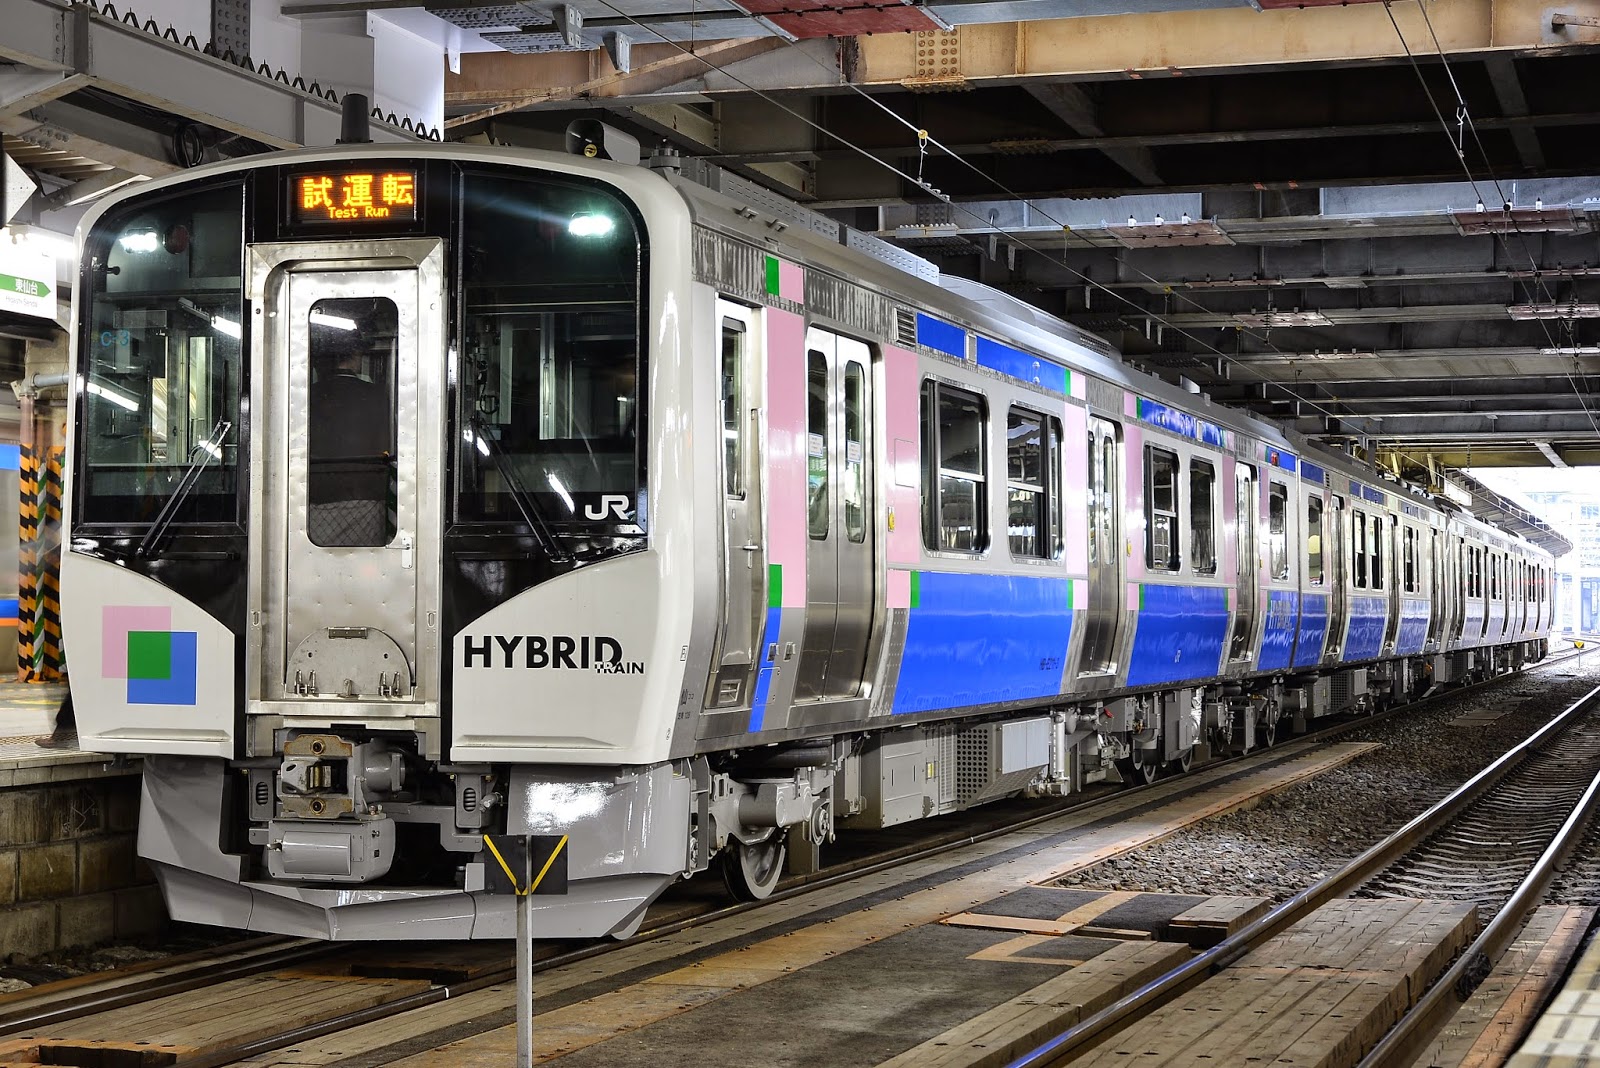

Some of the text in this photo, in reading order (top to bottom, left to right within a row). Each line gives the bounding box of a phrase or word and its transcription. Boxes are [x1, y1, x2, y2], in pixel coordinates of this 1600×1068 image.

[303, 174, 413, 208] 試運転
[328, 205, 389, 219] Test Run
[15, 278, 38, 296] 東仙台
[101, 329, 129, 347] C-3
[584, 494, 630, 520] JR
[463, 635, 623, 669] HYBRID
[594, 661, 645, 674] TRAIN
